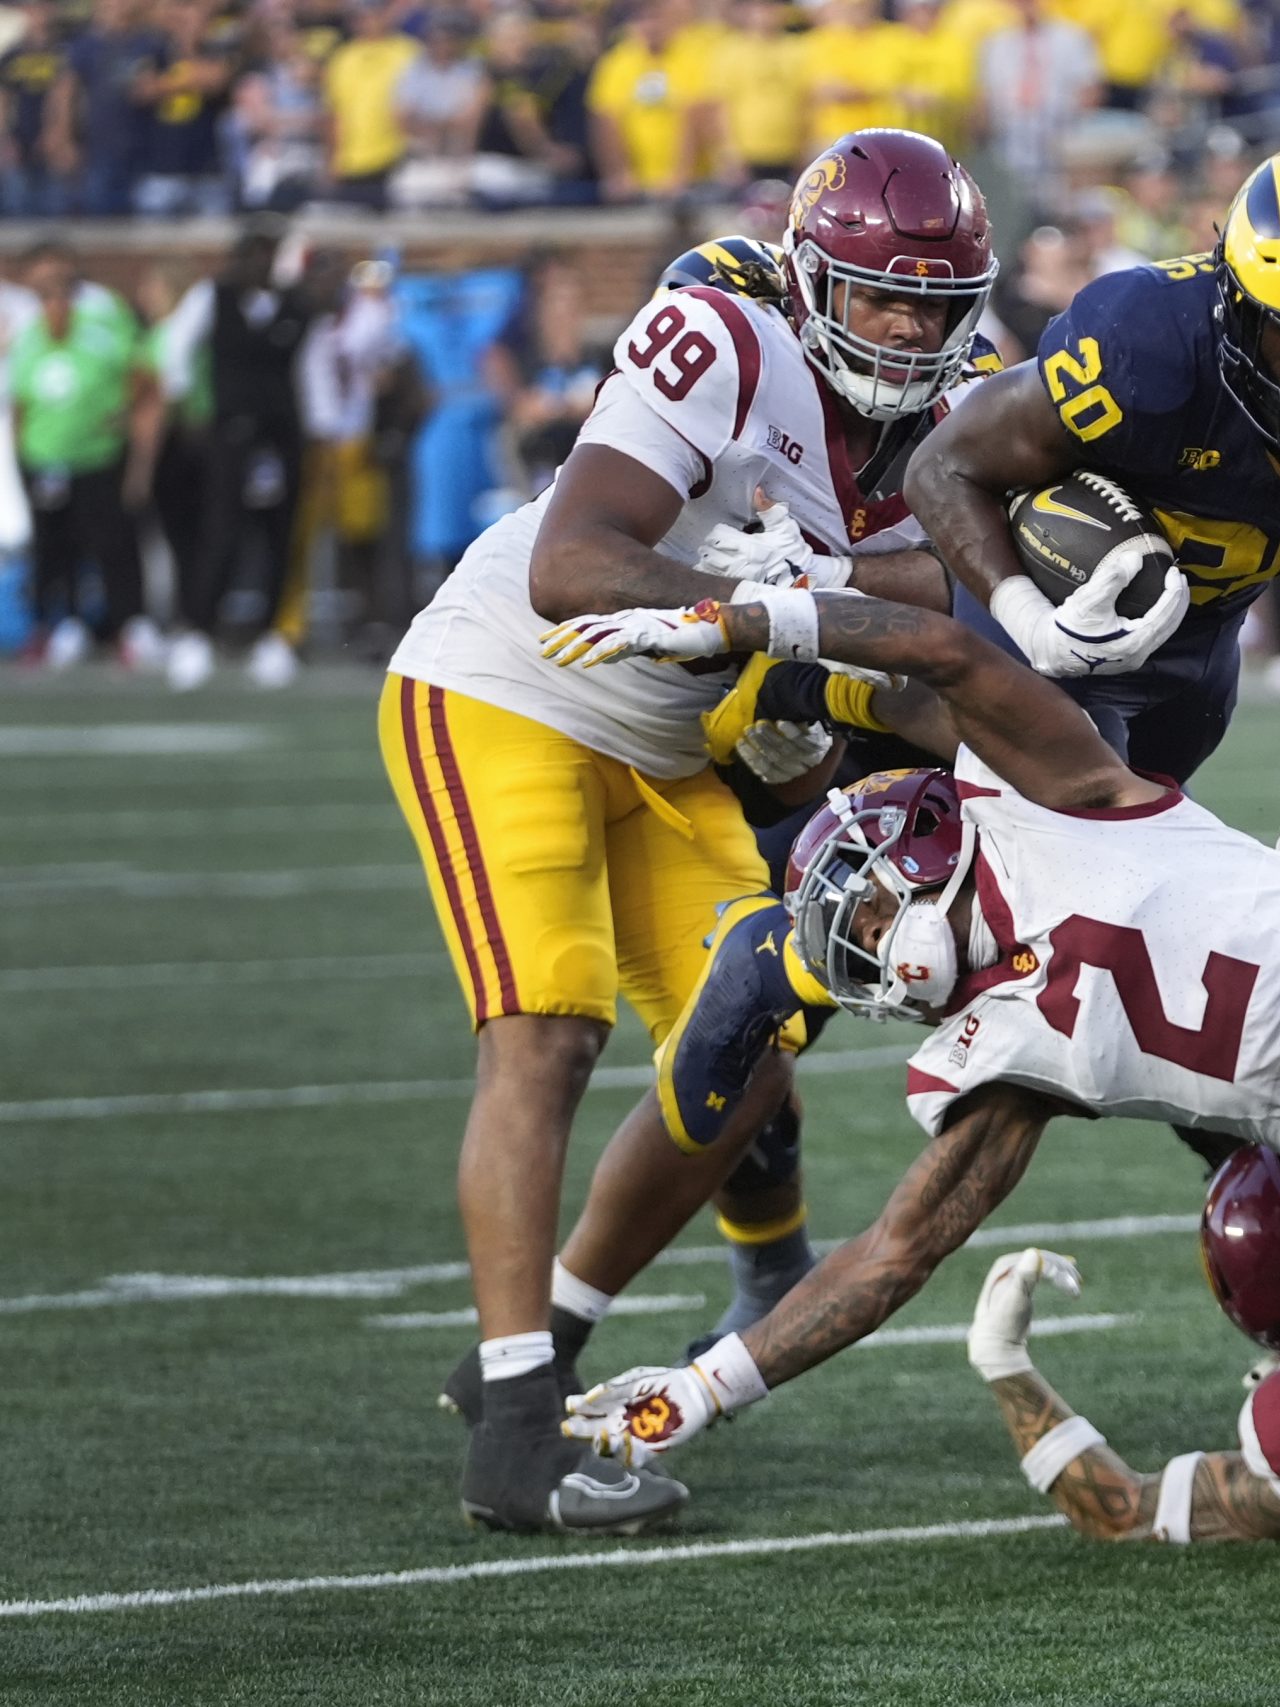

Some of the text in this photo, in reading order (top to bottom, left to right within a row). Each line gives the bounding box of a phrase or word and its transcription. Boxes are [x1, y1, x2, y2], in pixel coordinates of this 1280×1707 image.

[628, 305, 717, 402] 99
[1044, 336, 1123, 442] 20
[1036, 913, 1261, 1084] 2
